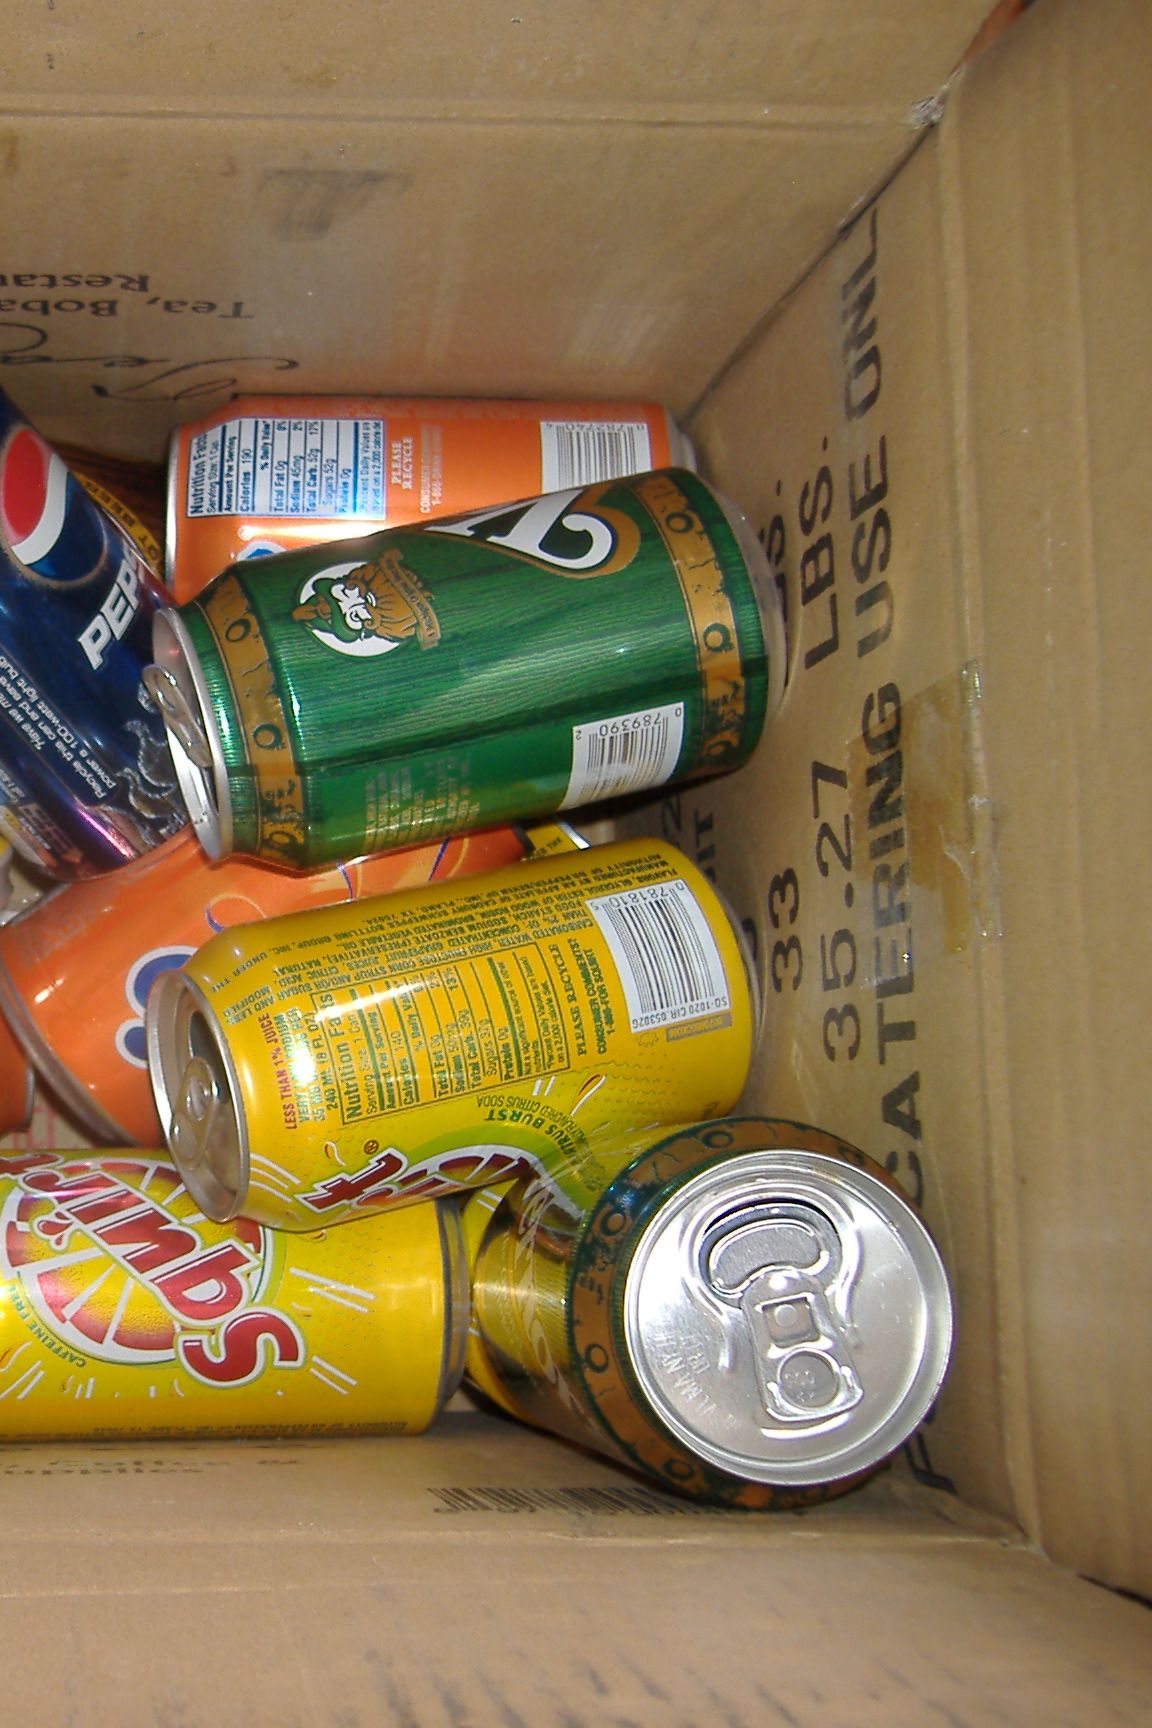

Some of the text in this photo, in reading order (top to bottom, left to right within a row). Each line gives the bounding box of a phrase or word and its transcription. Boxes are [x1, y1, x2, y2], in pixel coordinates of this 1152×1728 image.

[145, 295, 254, 318] Tea,
[291, 454, 303, 477] 45mg
[307, 447, 320, 462] 52g
[391, 440, 402, 483] PLEASE
[402, 436, 412, 489] RECYCLE
[190, 459, 206, 514] Nutrition
[223, 464, 235, 512] Amount Per
[240, 471, 251, 512] Calories
[274, 460, 287, 512] Total Fat 0g
[306, 464, 318, 486] Carb.
[322, 475, 334, 504] Sugars
[207, 480, 219, 512] Serving
[289, 479, 300, 512] Sodium
[305, 488, 316, 512] Total
[77, 562, 140, 670] PEP
[13, 672, 45, 704] light
[840, 208, 925, 1200] CATERING USE ONL
[6, 706, 25, 725] we
[16, 699, 41, 723] and
[31, 699, 84, 750] 100-watt
[597, 712, 662, 736] 789390
[674, 707, 682, 717] 0
[34, 720, 57, 742] can
[799, 436, 860, 1061] 35.27 LBS.
[52, 739, 75, 762] this
[67, 759, 109, 799] Recycle
[83, 755, 118, 789] power
[607, 884, 668, 908] 781810
[768, 867, 803, 993] 33
[548, 941, 590, 1056] PLEASE RECYCLE
[567, 935, 611, 1054] CONSUMER COMMENTS?
[257, 1011, 298, 1130] LESS THAN 1% JUICE
[319, 992, 364, 1119] Nutrition Fats
[430, 1049, 451, 1096] Total Fat
[479, 1039, 502, 1076] Sugars
[293, 1090, 311, 1123] VERY
[323, 1087, 339, 1110] 240
[359, 1073, 380, 1114] Serving
[483, 1099, 545, 1139] BURST
[25, 1315, 88, 1370] CAFFEINE
